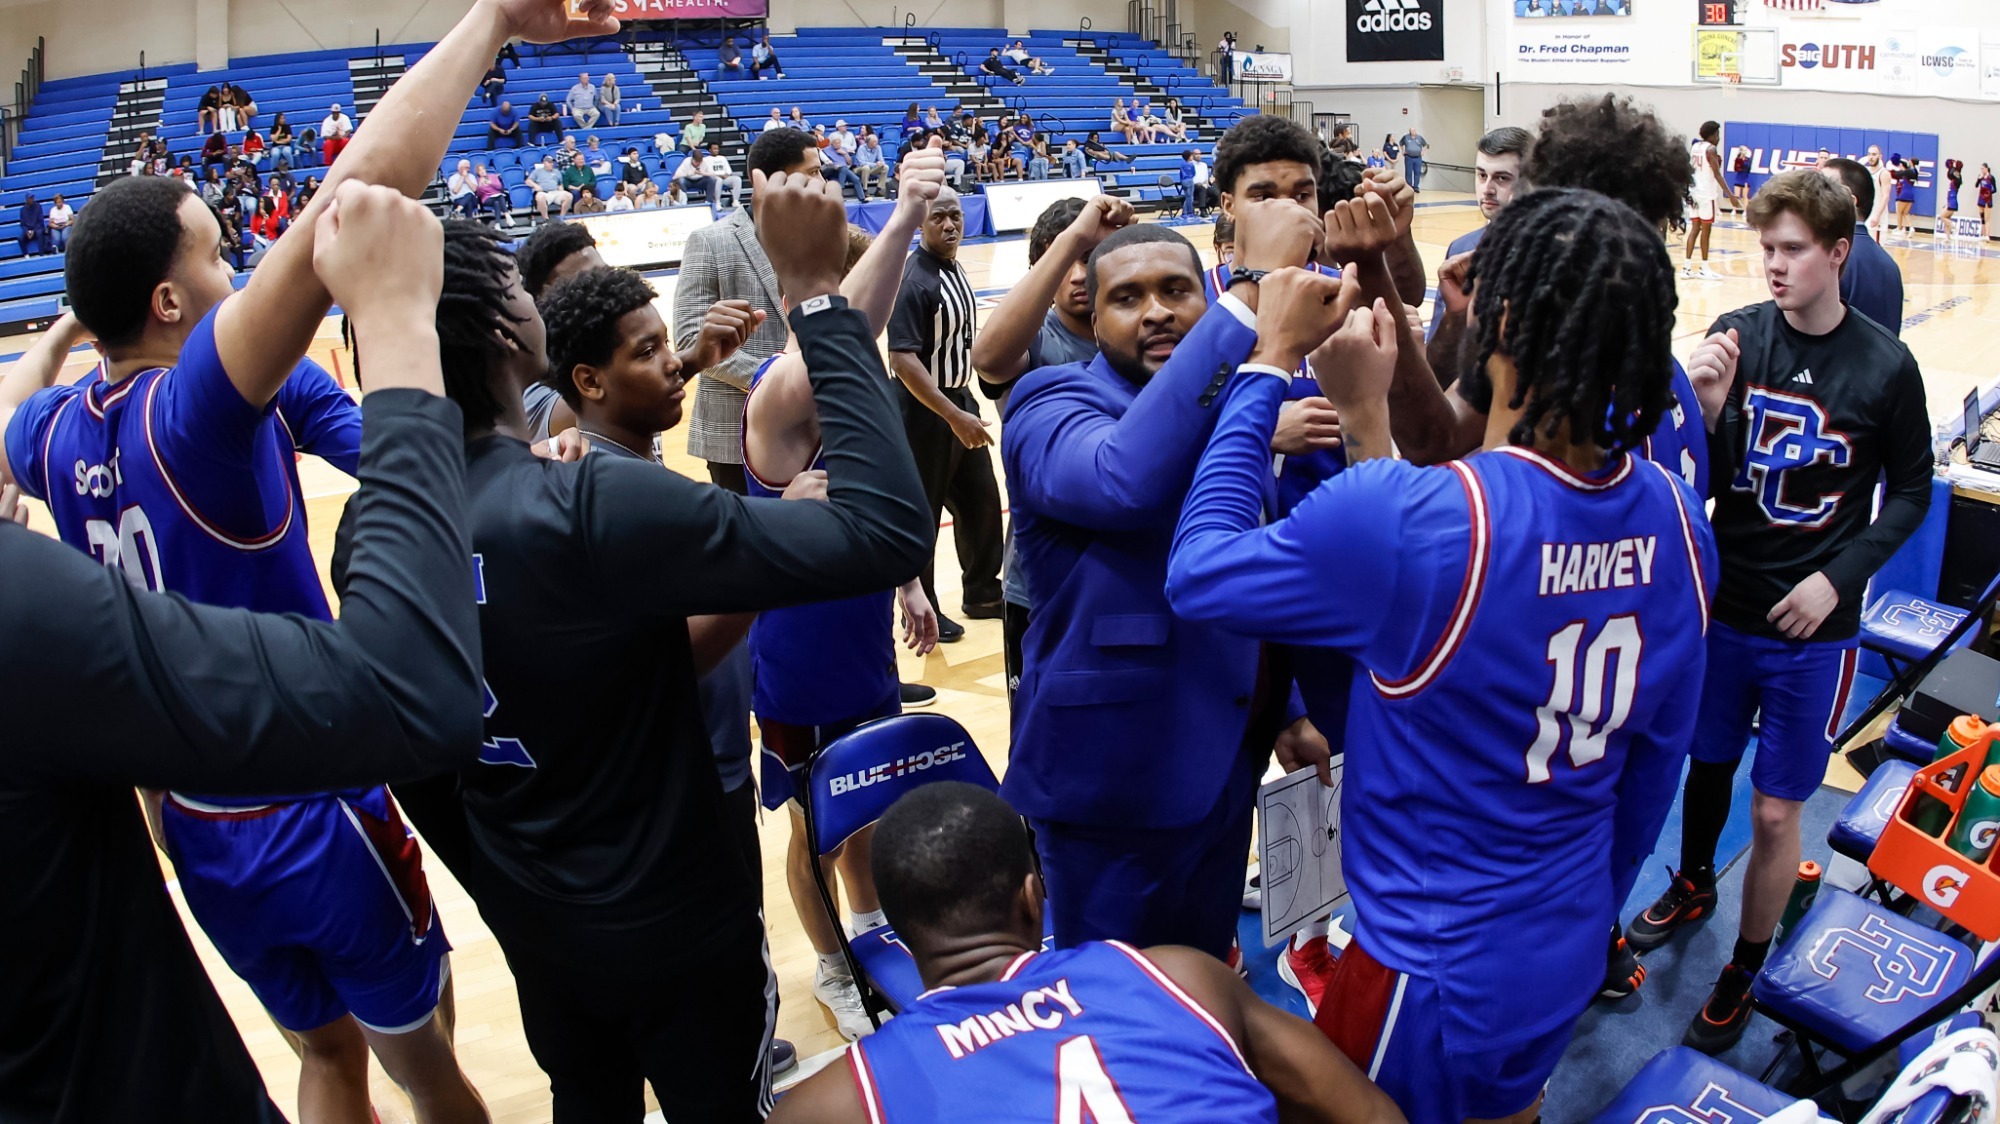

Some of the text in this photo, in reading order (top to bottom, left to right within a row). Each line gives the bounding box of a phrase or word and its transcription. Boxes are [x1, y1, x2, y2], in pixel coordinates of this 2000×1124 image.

[1356, 8, 1432, 33] adidas
[1704, 4, 1727, 23] 30
[1518, 44, 1630, 55] Dr. Fred Chapman
[1799, 50, 1821, 62] BIG
[1921, 55, 1954, 68] LCWSC
[1958, 219, 1981, 238] HOSE
[1538, 535, 1657, 596] HARVEY
[1525, 613, 1644, 784] 10
[829, 741, 966, 797] BLUE HOSE
[1922, 864, 1971, 908] G
[935, 977, 1084, 1060] MINCY
